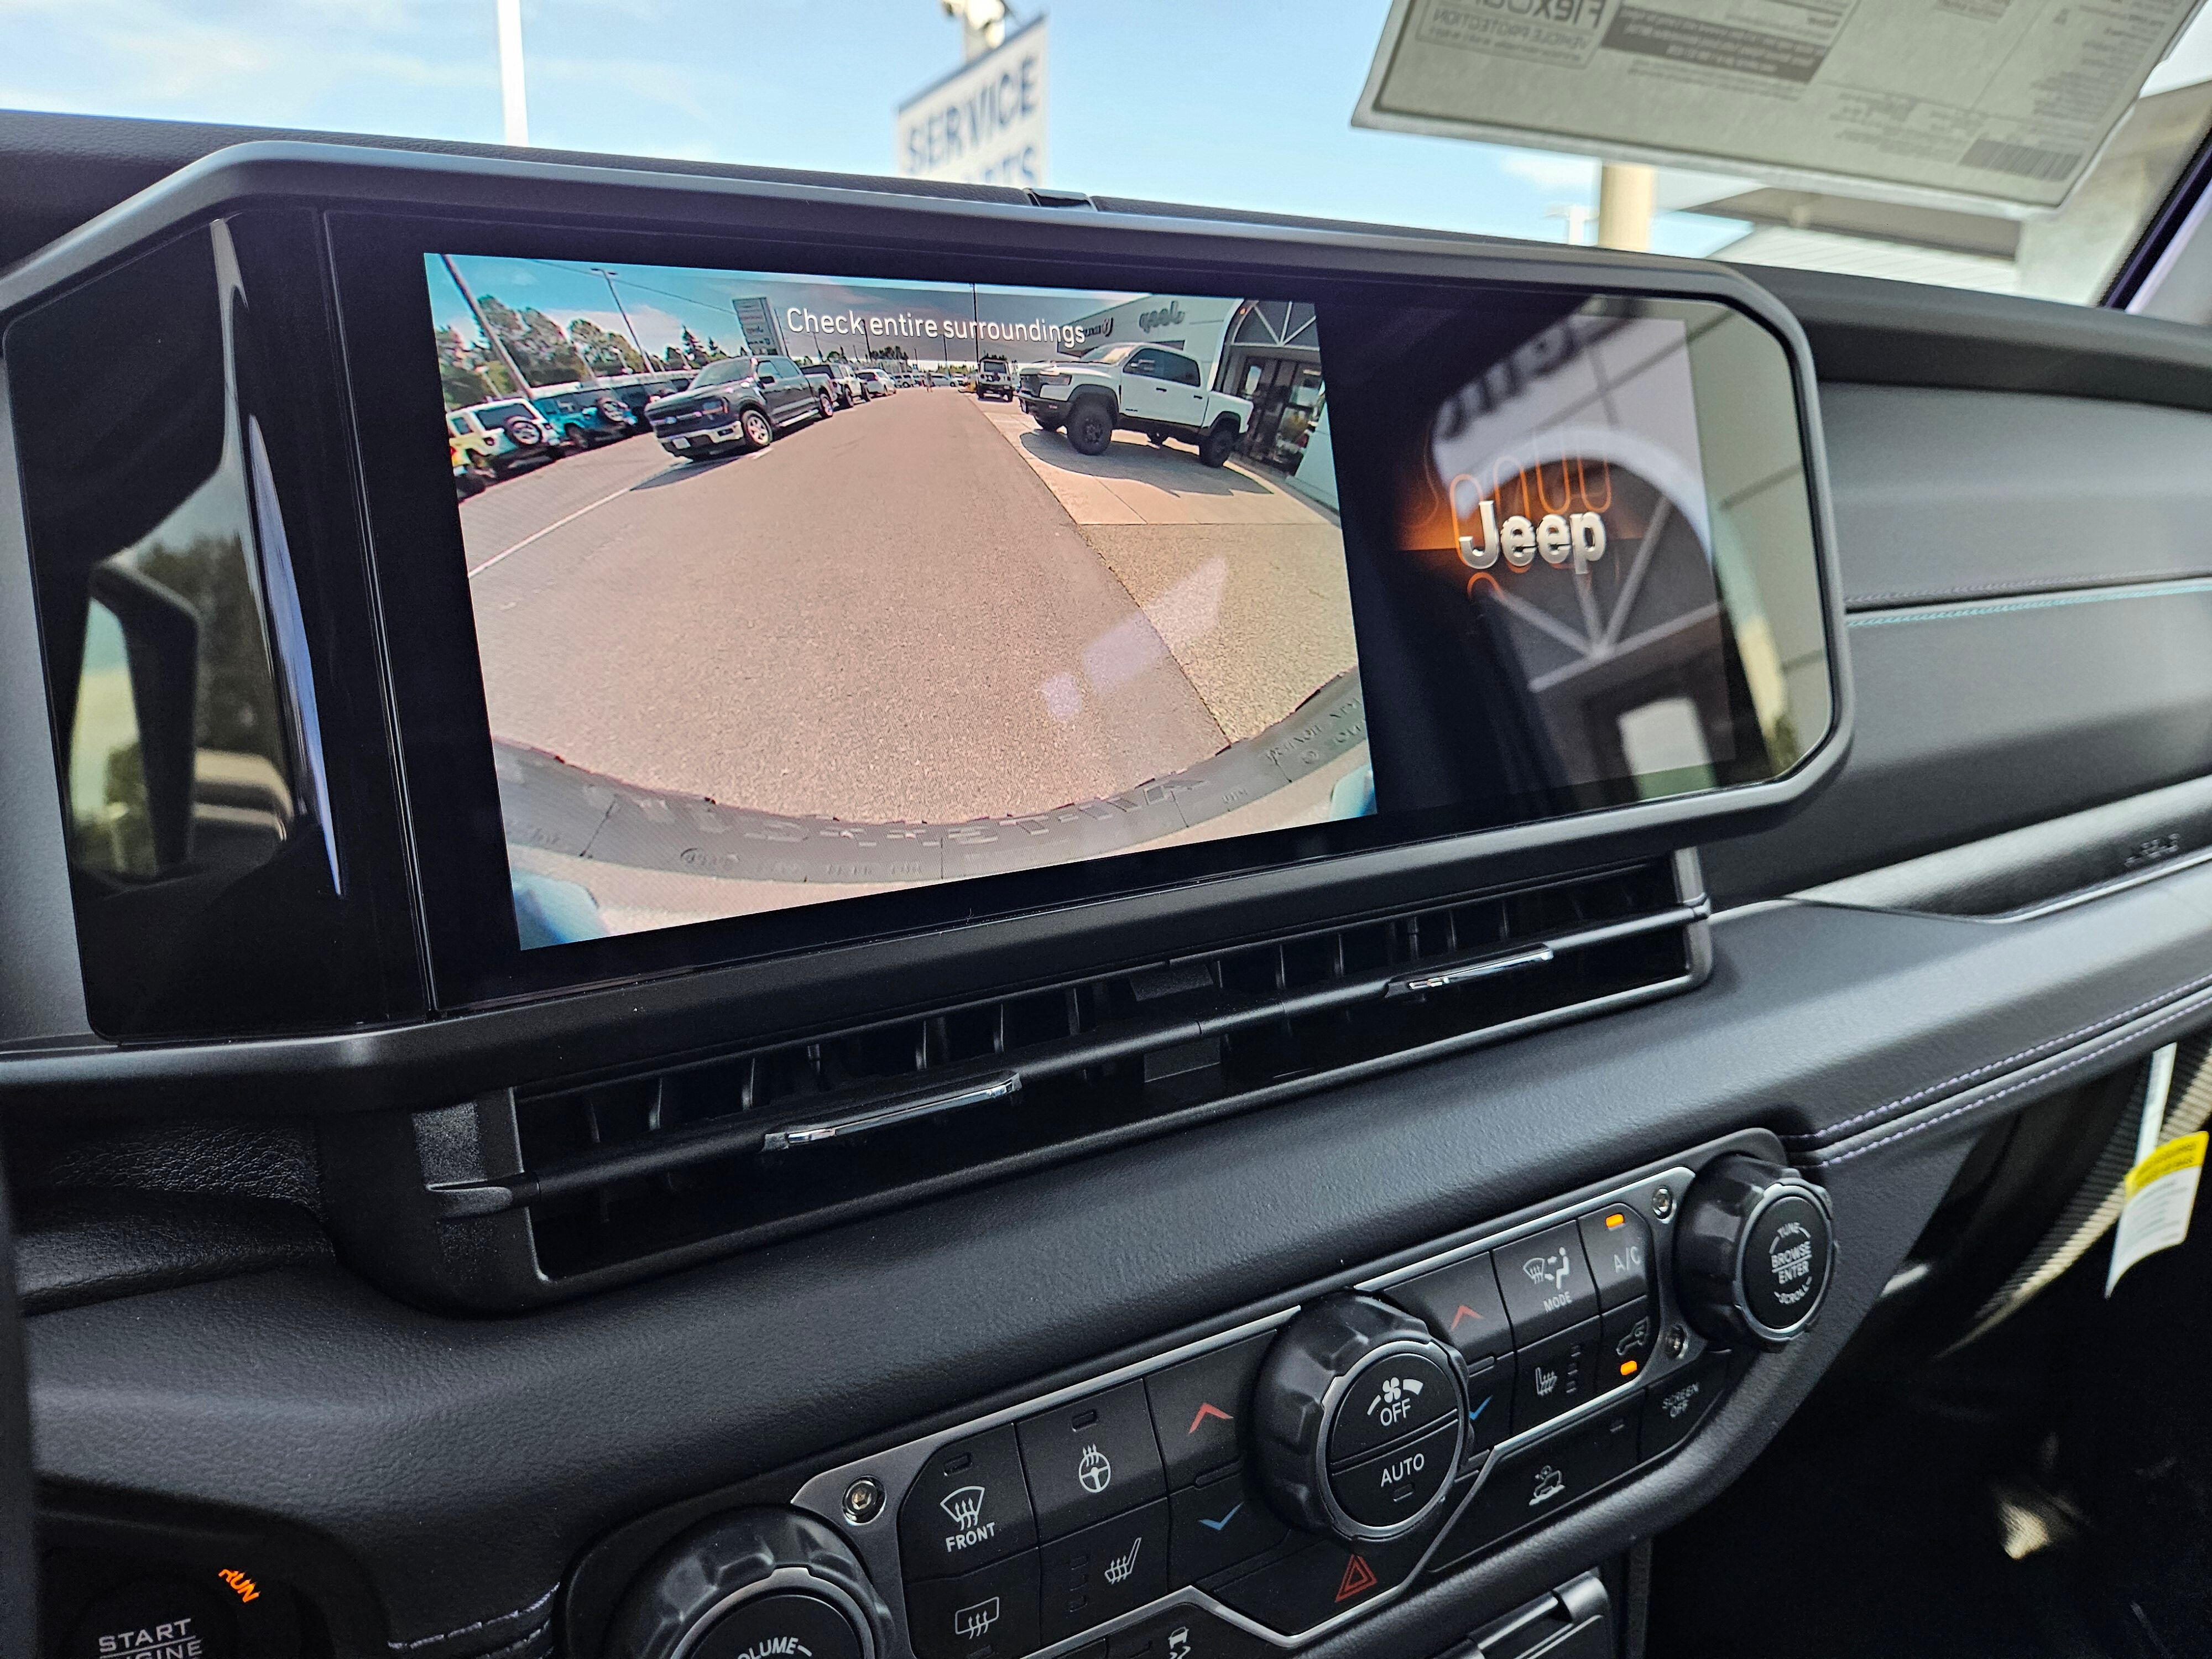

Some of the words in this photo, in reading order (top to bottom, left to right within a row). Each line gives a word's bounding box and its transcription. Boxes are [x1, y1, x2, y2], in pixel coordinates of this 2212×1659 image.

[909, 54, 1037, 174] SERVICE
[787, 307, 865, 335] Check
[870, 312, 938, 338] entire
[943, 319, 1086, 348] surroundings
[1458, 500, 1606, 575] Jeep
[1777, 1222, 1801, 1238] TUNE
[1614, 1246, 1641, 1273] A/C
[1771, 1240, 1812, 1268] BROWSE
[1778, 1260, 1809, 1285] ENTER
[1543, 1291, 1572, 1312] MODE
[1778, 1284, 1810, 1305] SCROLL
[1662, 1383, 1699, 1410] SCREEN
[1670, 1399, 1689, 1418] OFF
[1380, 1397, 1411, 1426] OFF
[1380, 1453, 1425, 1487] AUTO
[945, 1521, 995, 1553] FRONT
[218, 1568, 261, 1603] RUN
[98, 1618, 191, 1653] START
